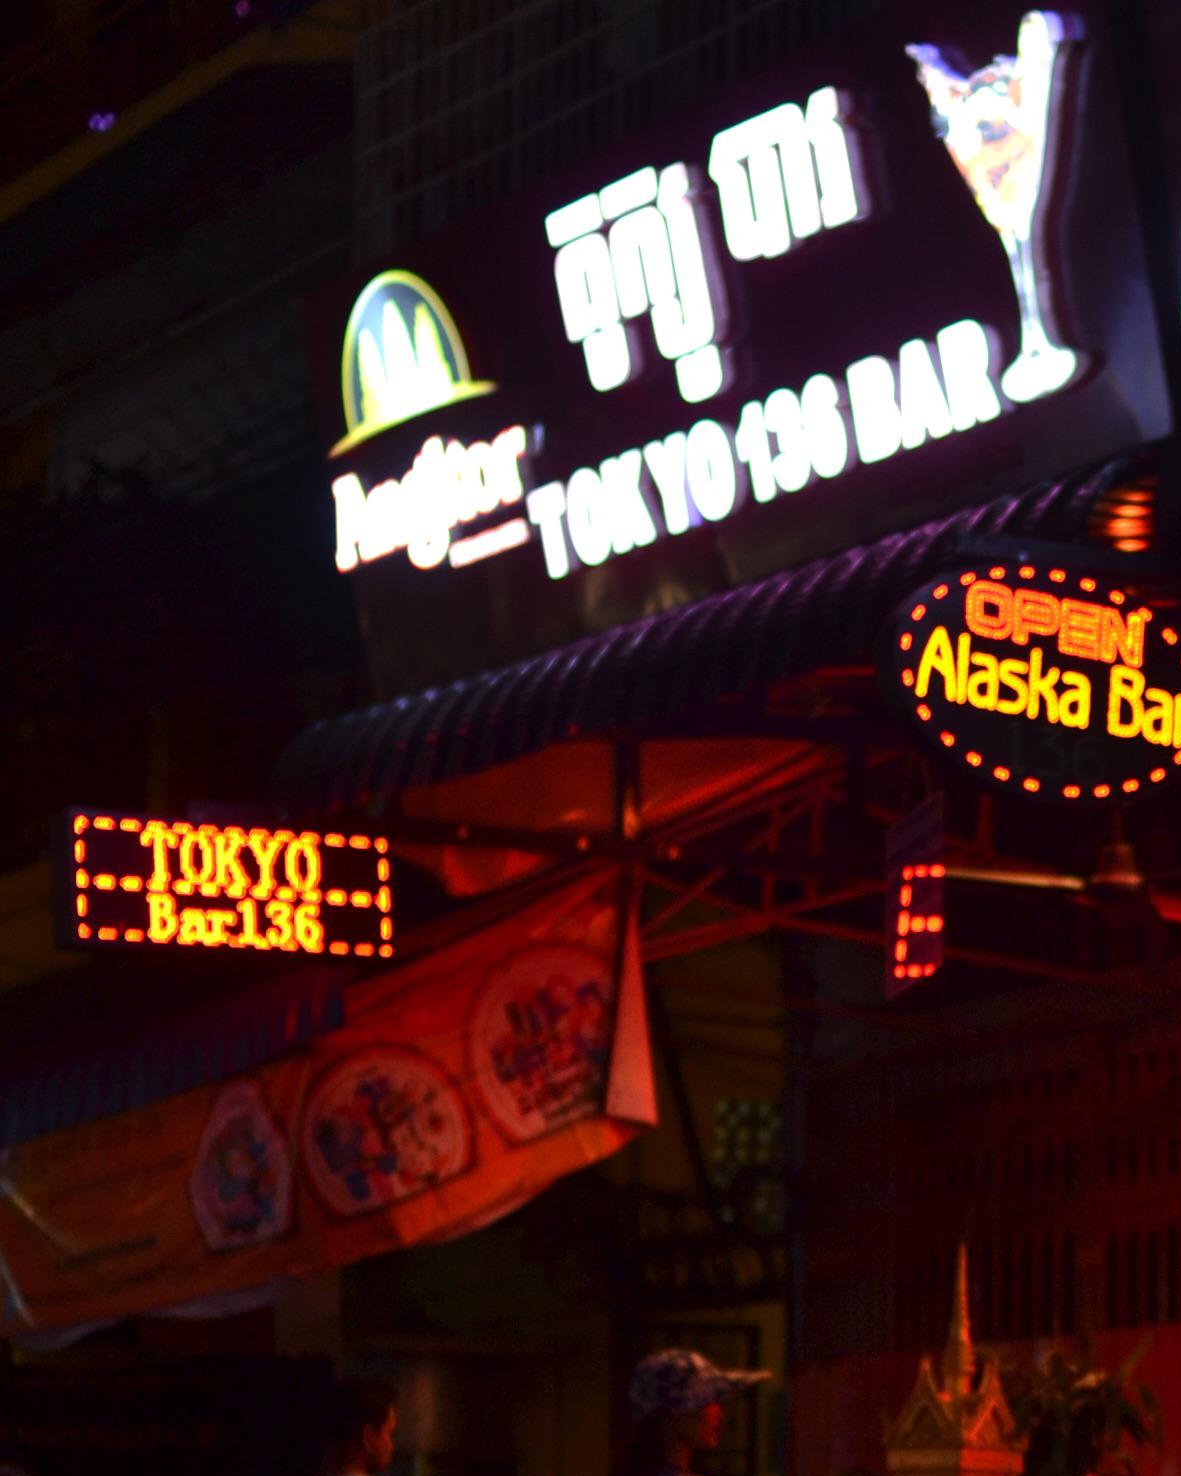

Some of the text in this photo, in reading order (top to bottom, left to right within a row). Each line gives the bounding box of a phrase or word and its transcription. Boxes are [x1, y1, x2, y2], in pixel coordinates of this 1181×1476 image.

[332, 426, 528, 573] Angkor
[527, 319, 1002, 579] TOKYO 136 BAR
[965, 579, 1147, 669] OPEN
[915, 625, 1091, 730] Alaska
[140, 824, 322, 900] TOKYO
